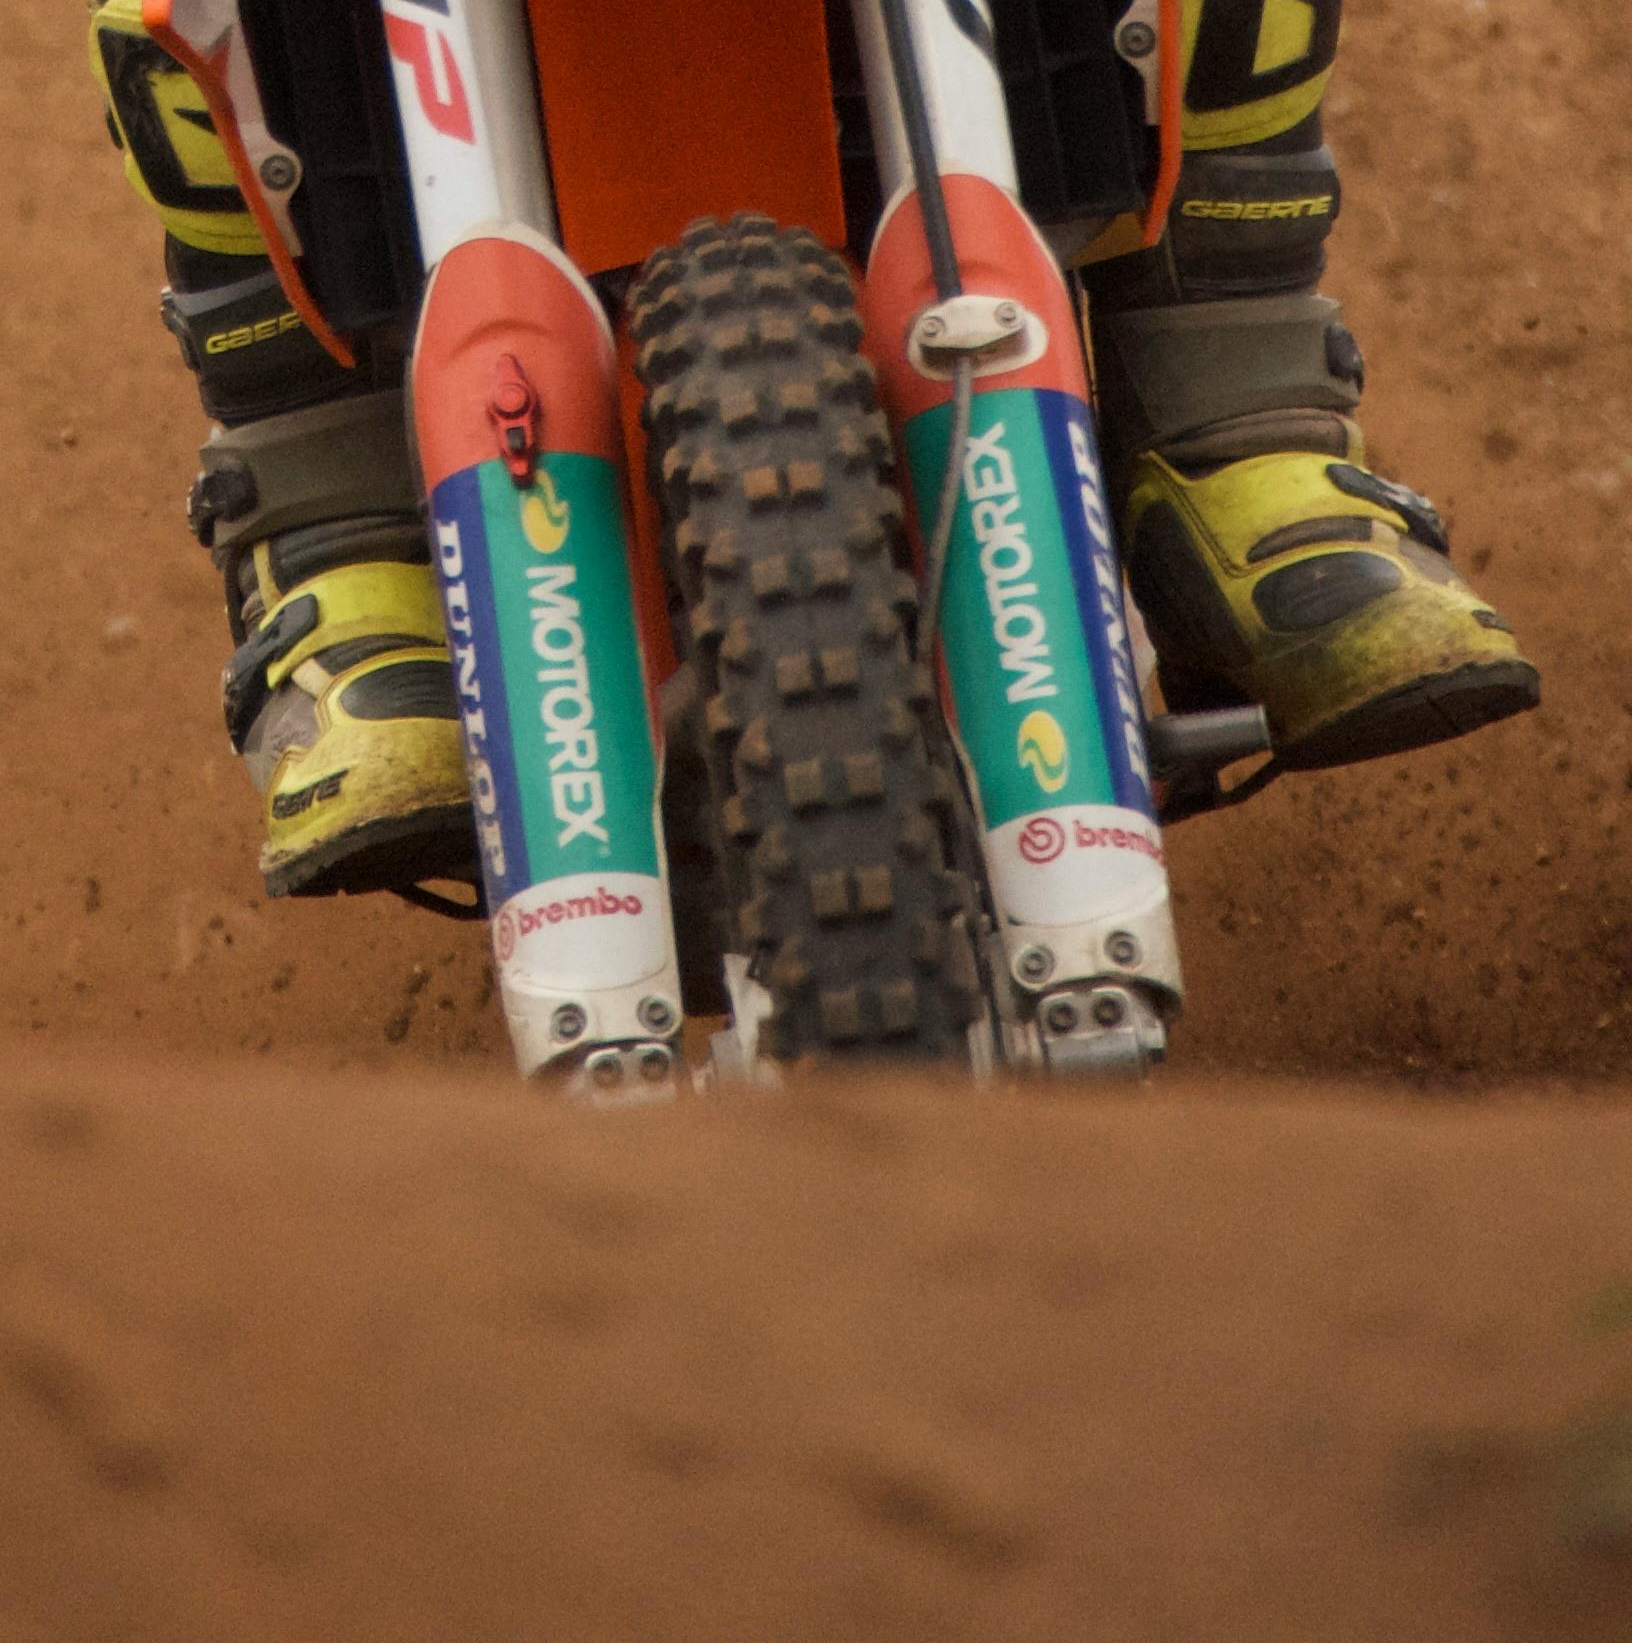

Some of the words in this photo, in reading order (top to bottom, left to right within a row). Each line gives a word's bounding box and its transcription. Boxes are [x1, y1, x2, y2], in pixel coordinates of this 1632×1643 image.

[206, 311, 302, 355] GAER
[964, 420, 1060, 705] MOTOREX
[435, 518, 507, 877] DUNLOP
[524, 563, 610, 849] MOTOREX
[517, 886, 643, 937] brembo
[1072, 819, 1165, 863] brem
